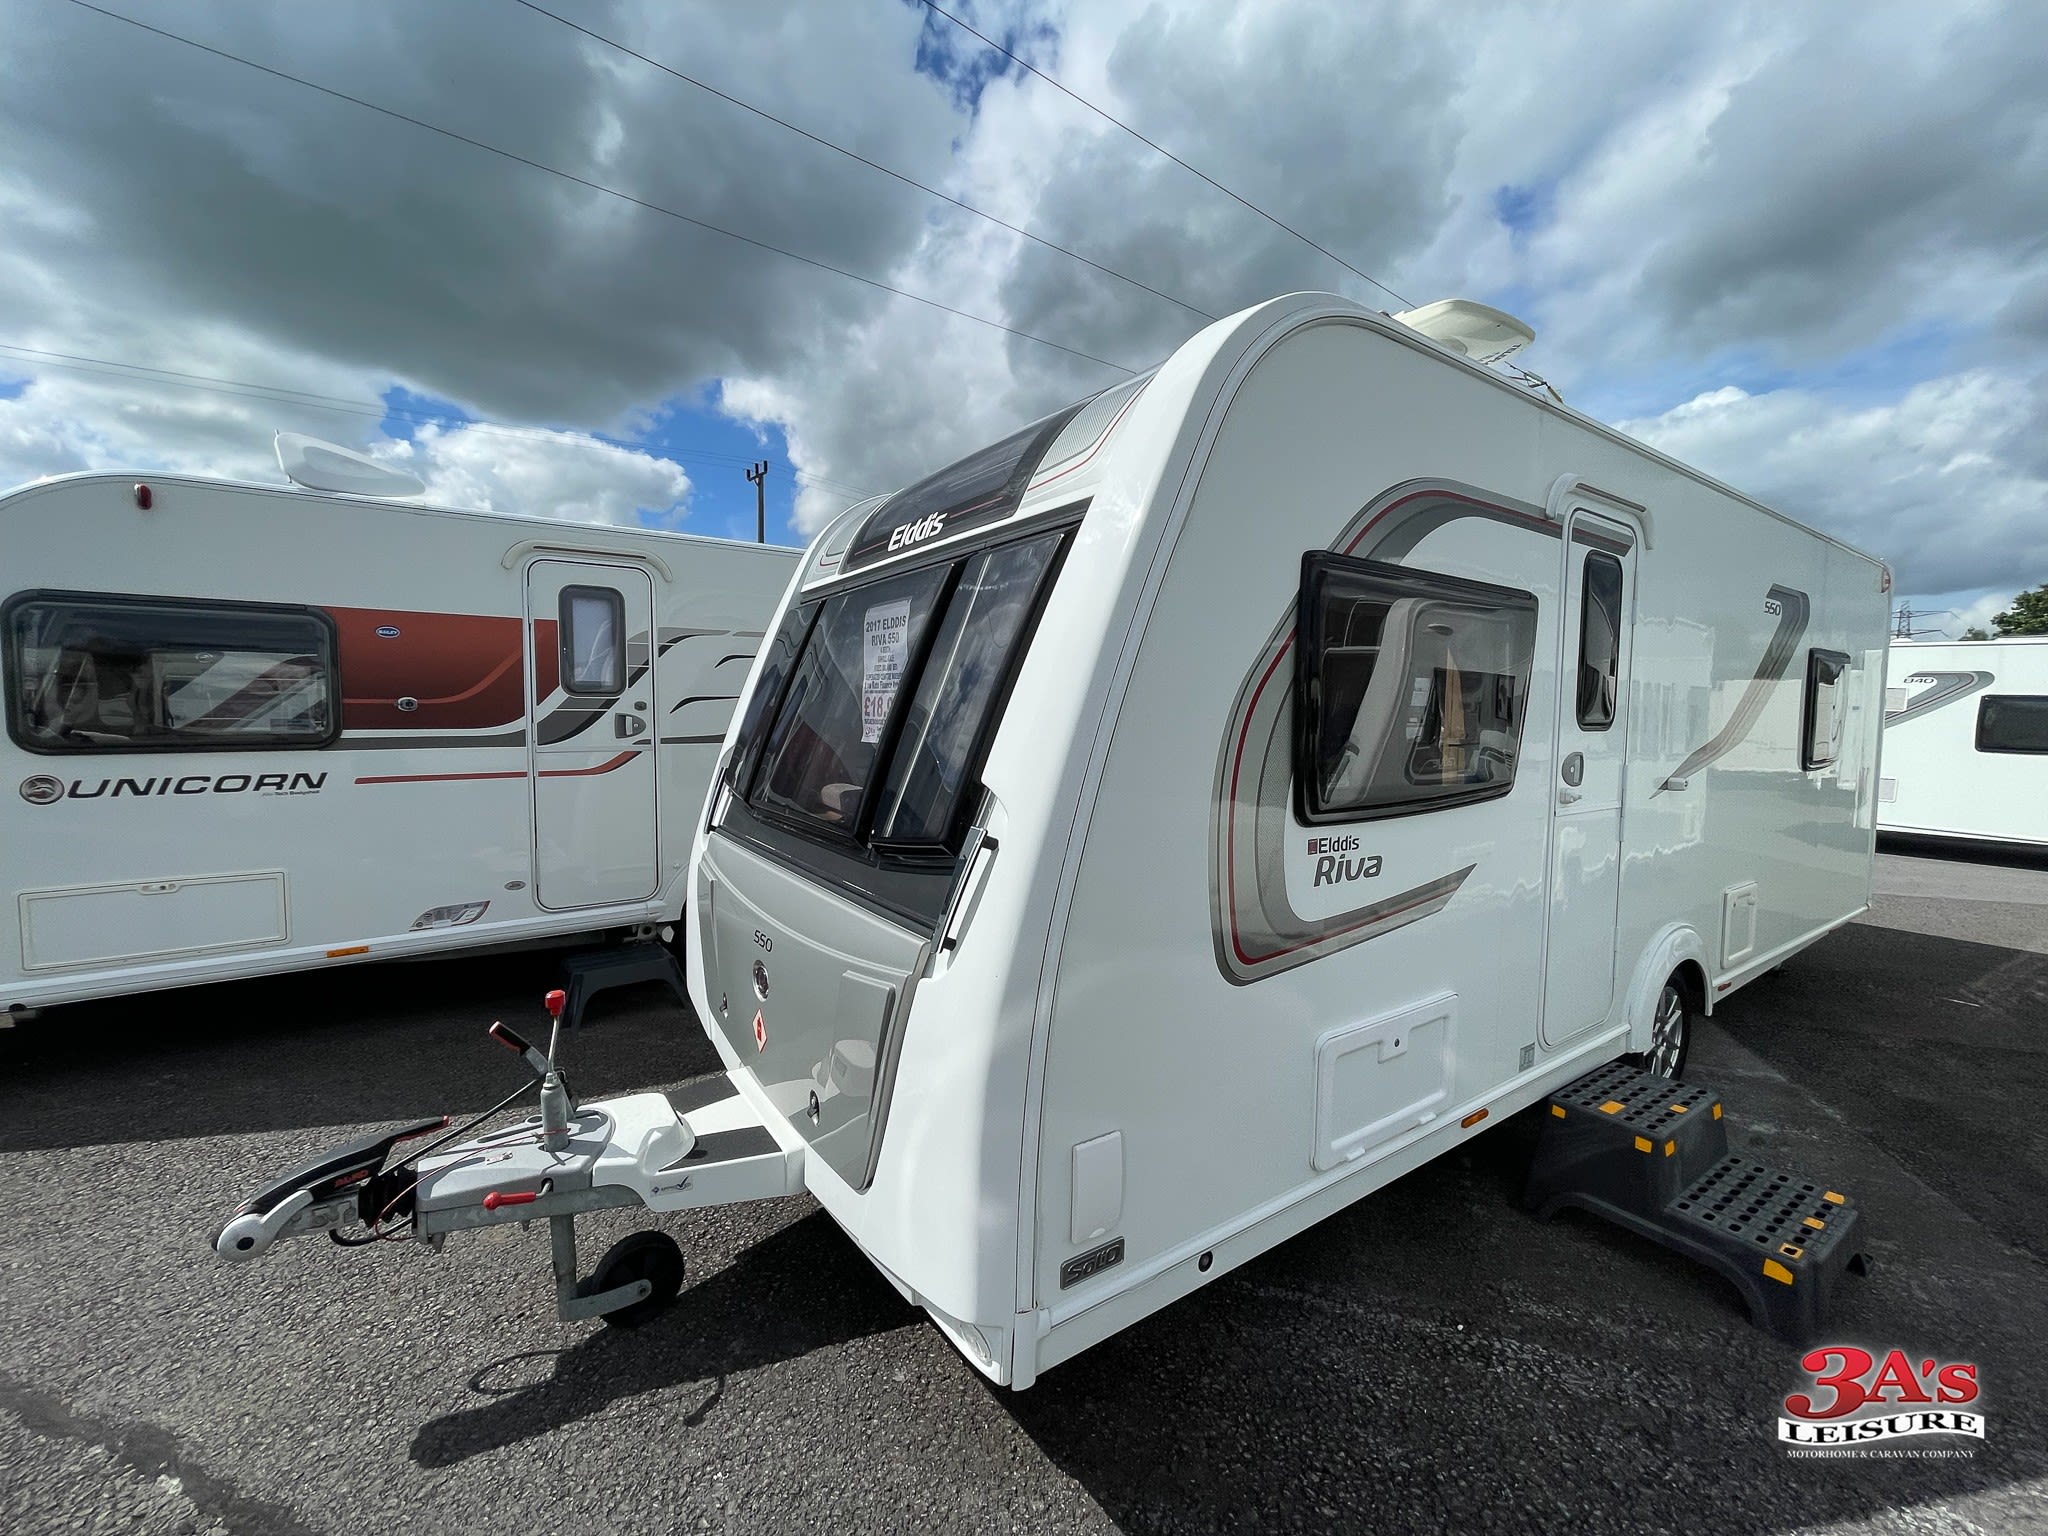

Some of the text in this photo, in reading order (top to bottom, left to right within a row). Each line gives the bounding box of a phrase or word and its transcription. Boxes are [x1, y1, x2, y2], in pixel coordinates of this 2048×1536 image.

[887, 511, 948, 552] Elddis
[1764, 600, 1781, 616] 550
[866, 615, 907, 633] 2017 ELDDIS
[871, 631, 900, 646] RIVA 550
[67, 771, 329, 799] UNICORN
[1318, 835, 1360, 854] Elddis
[1313, 853, 1383, 888] Riva
[753, 929, 773, 953] 550
